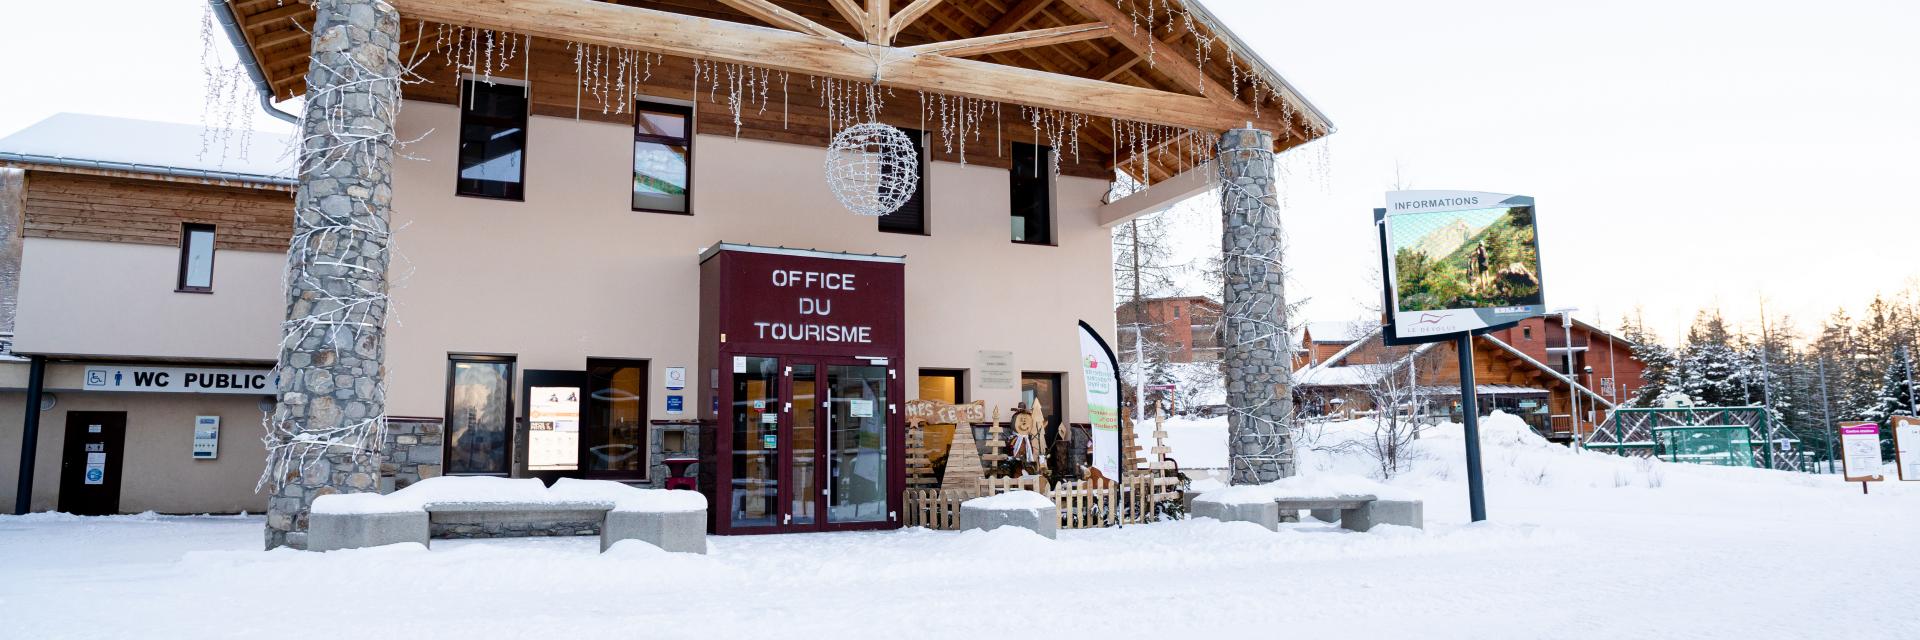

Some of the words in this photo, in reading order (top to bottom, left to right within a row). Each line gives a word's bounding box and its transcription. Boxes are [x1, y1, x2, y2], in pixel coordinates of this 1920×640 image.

[1395, 196, 1479, 210] INFORMATIONS
[772, 269, 855, 291] OFFICE
[799, 297, 831, 316] DU
[754, 322, 872, 343] TOURISME
[133, 371, 169, 387] WC
[184, 372, 266, 389] PUBLIC
